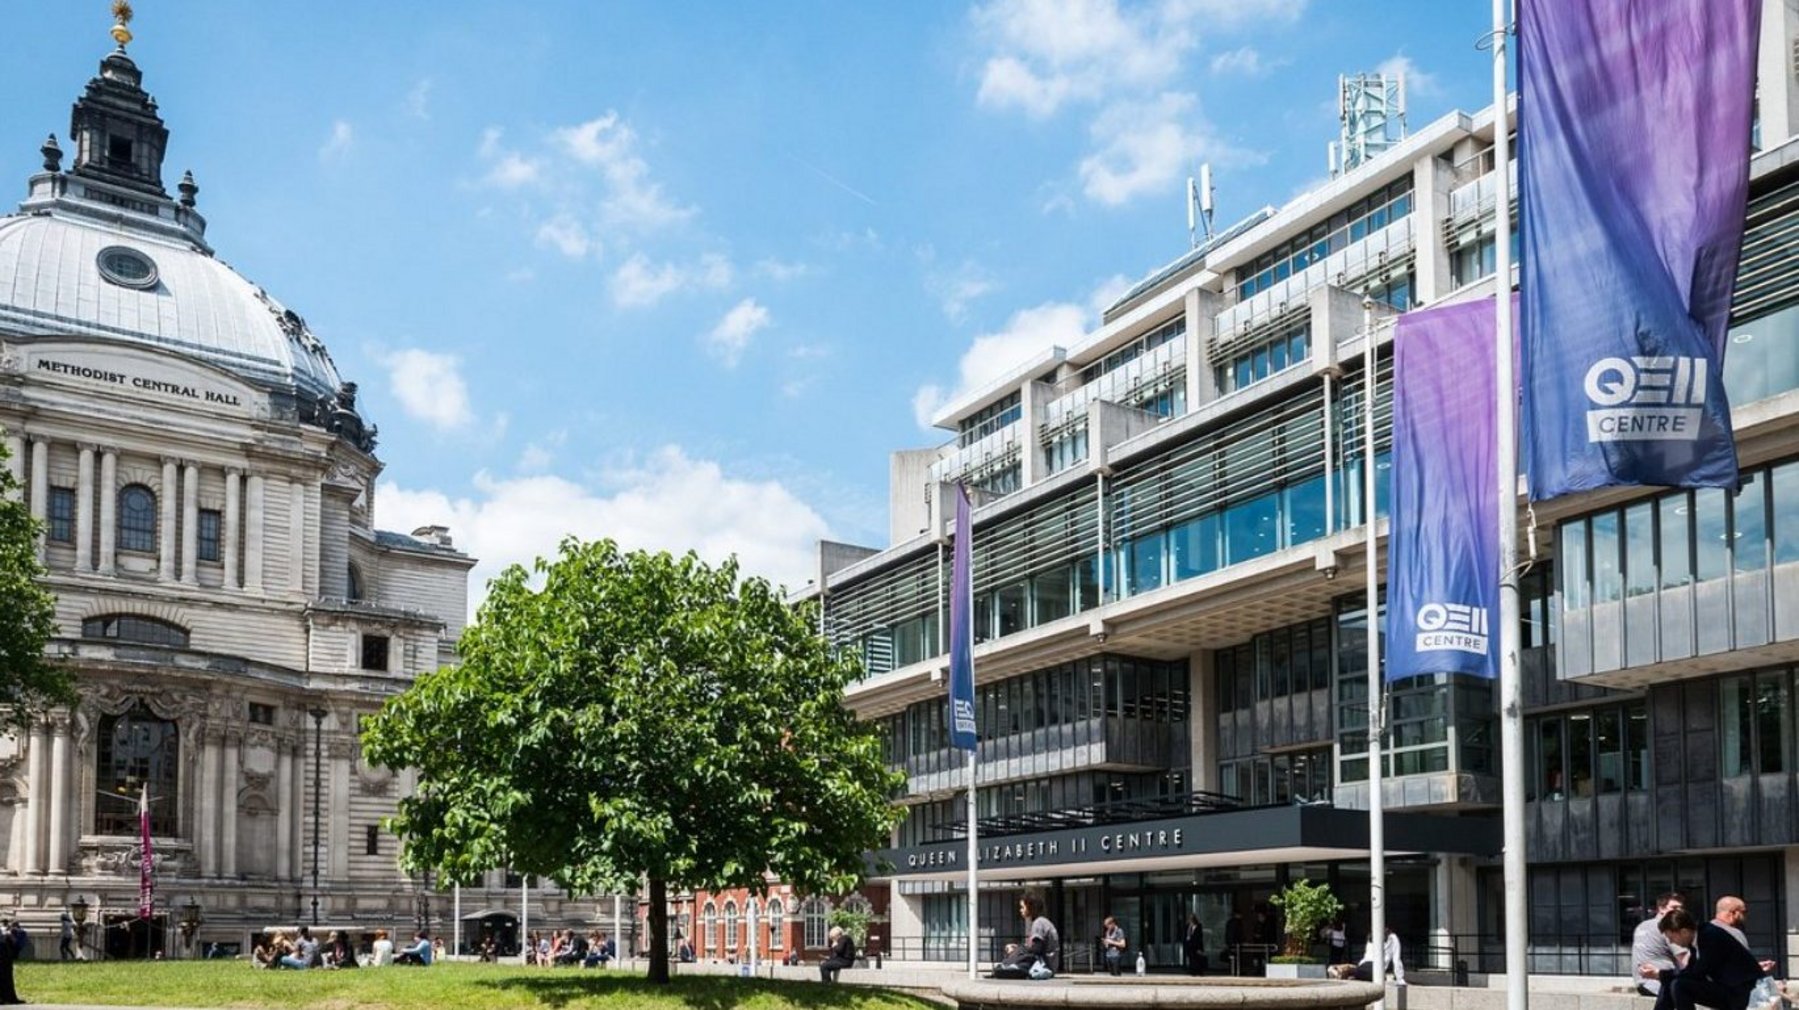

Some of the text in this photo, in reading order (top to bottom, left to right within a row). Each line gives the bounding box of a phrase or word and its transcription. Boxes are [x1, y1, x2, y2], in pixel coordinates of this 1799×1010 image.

[37, 358, 241, 407] METHODIST CENTRAL HALL
[1599, 415, 1687, 433] CENTRE
[1422, 635, 1481, 649] CENTRE
[908, 828, 1183, 867] QUEEN LIZABETH II CENTRE
